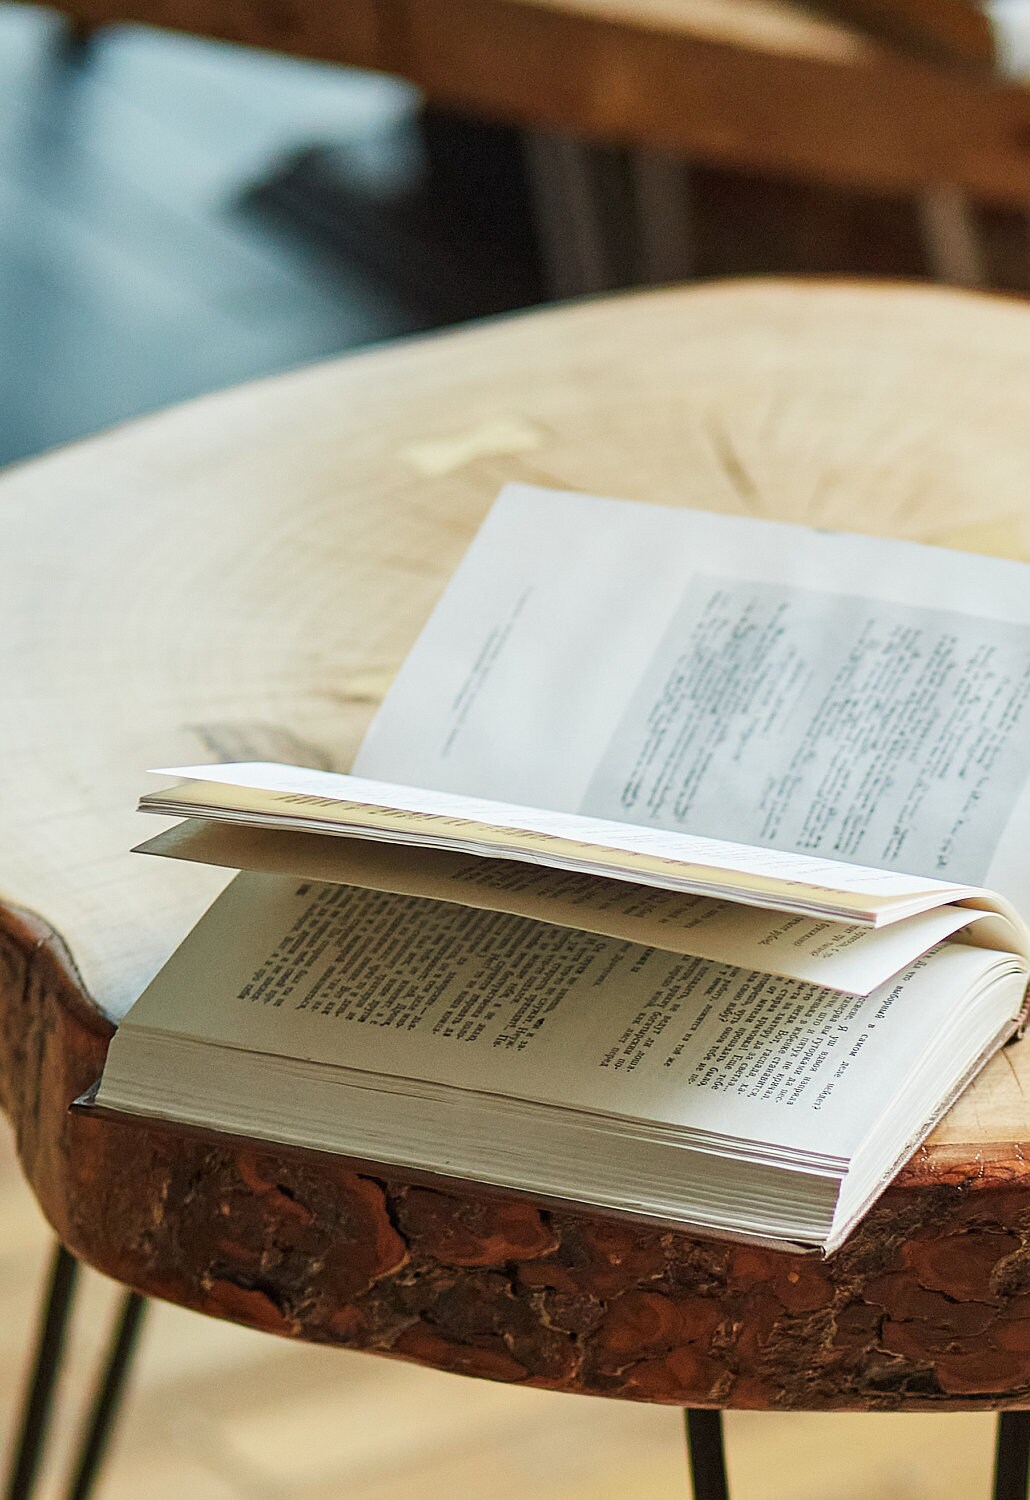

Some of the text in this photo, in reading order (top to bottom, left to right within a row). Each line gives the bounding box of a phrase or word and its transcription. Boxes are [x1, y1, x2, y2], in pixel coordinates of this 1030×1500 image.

[766, 989, 788, 1012] старая
[875, 986, 904, 1019] выборный
[718, 1002, 737, 1023] избу?
[768, 1030, 789, 1044] Вот,
[778, 1026, 803, 1054] избенке
[849, 1034, 868, 1056] самом
[703, 1046, 720, 1061] тебе
[697, 1067, 719, 1087] было,
[833, 1061, 849, 1078] деле
[711, 1074, 727, 1090] тебе
